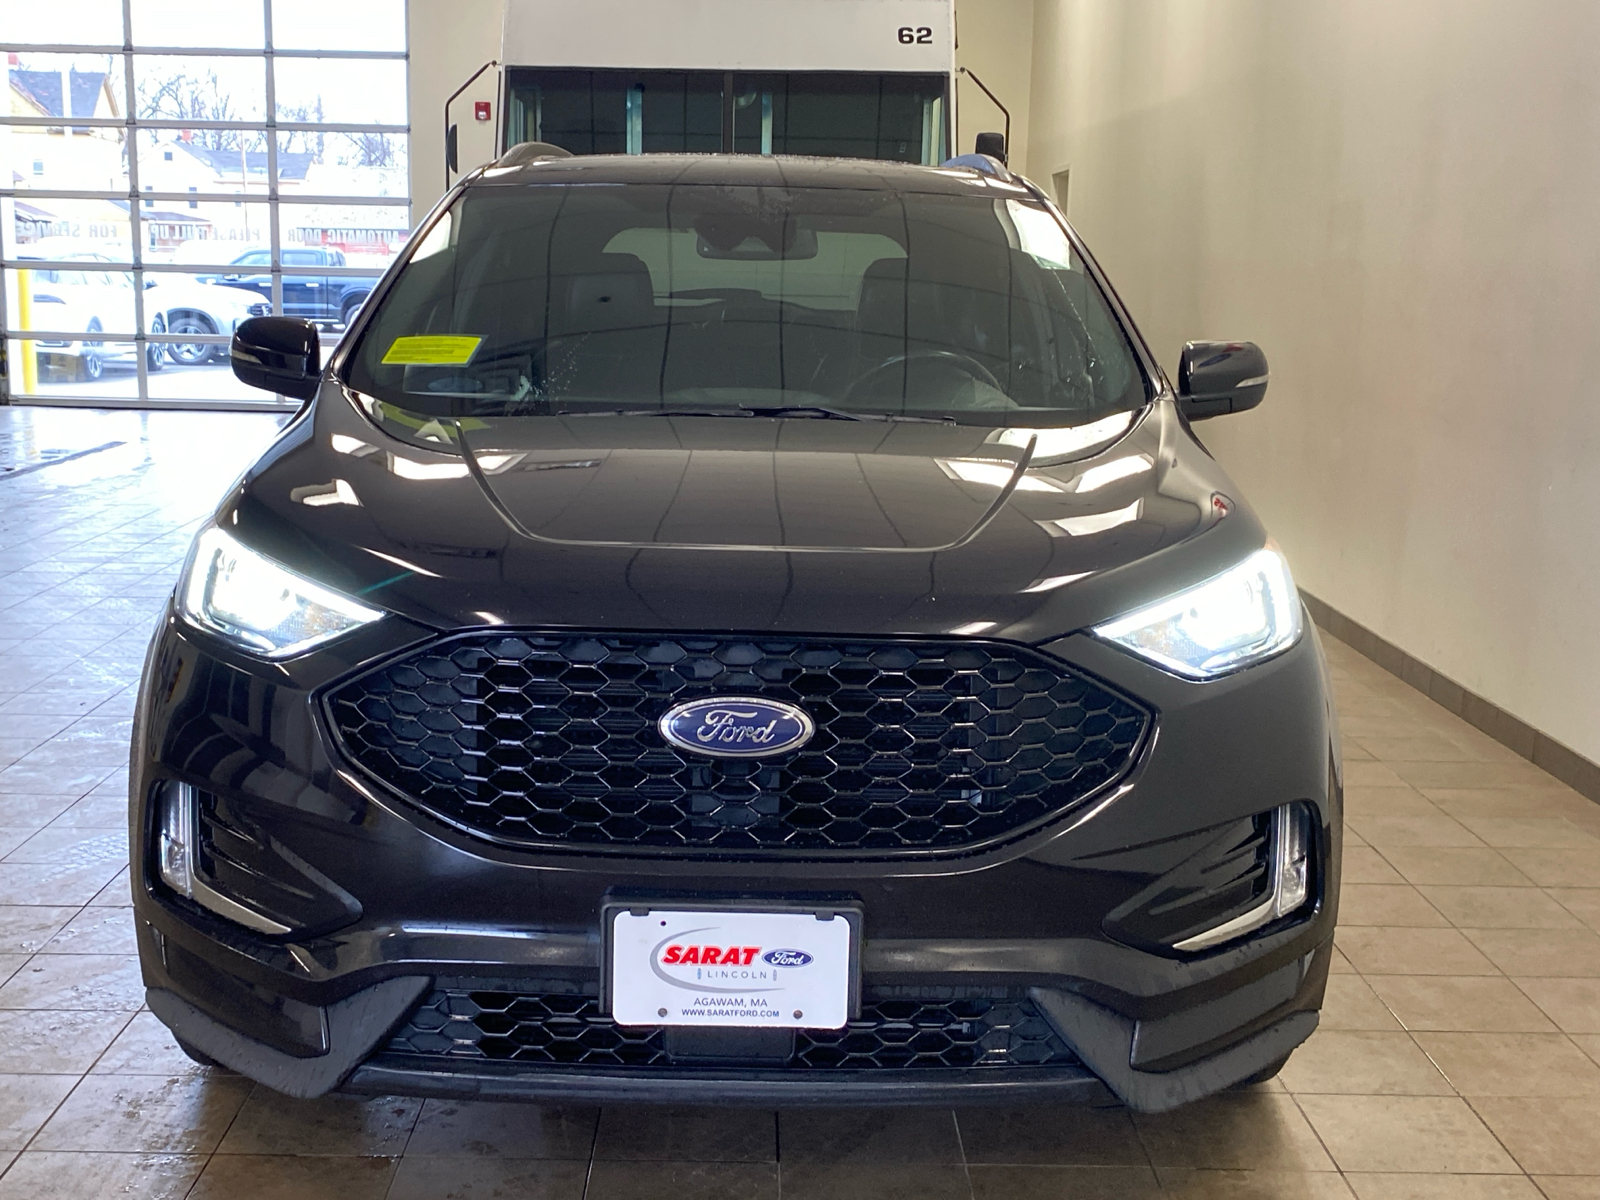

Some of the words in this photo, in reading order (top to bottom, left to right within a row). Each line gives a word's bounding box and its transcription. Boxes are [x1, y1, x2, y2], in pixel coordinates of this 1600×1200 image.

[898, 27, 932, 44] 62
[697, 710, 777, 743] Ford
[662, 945, 761, 966] SARAT
[770, 950, 804, 966] Ford
[707, 970, 767, 979] LINCOLN
[693, 997, 748, 1008] AGAWAM,
[750, 997, 768, 1007] MA
[681, 1008, 780, 1018] WWW.SARATFORD.COM
